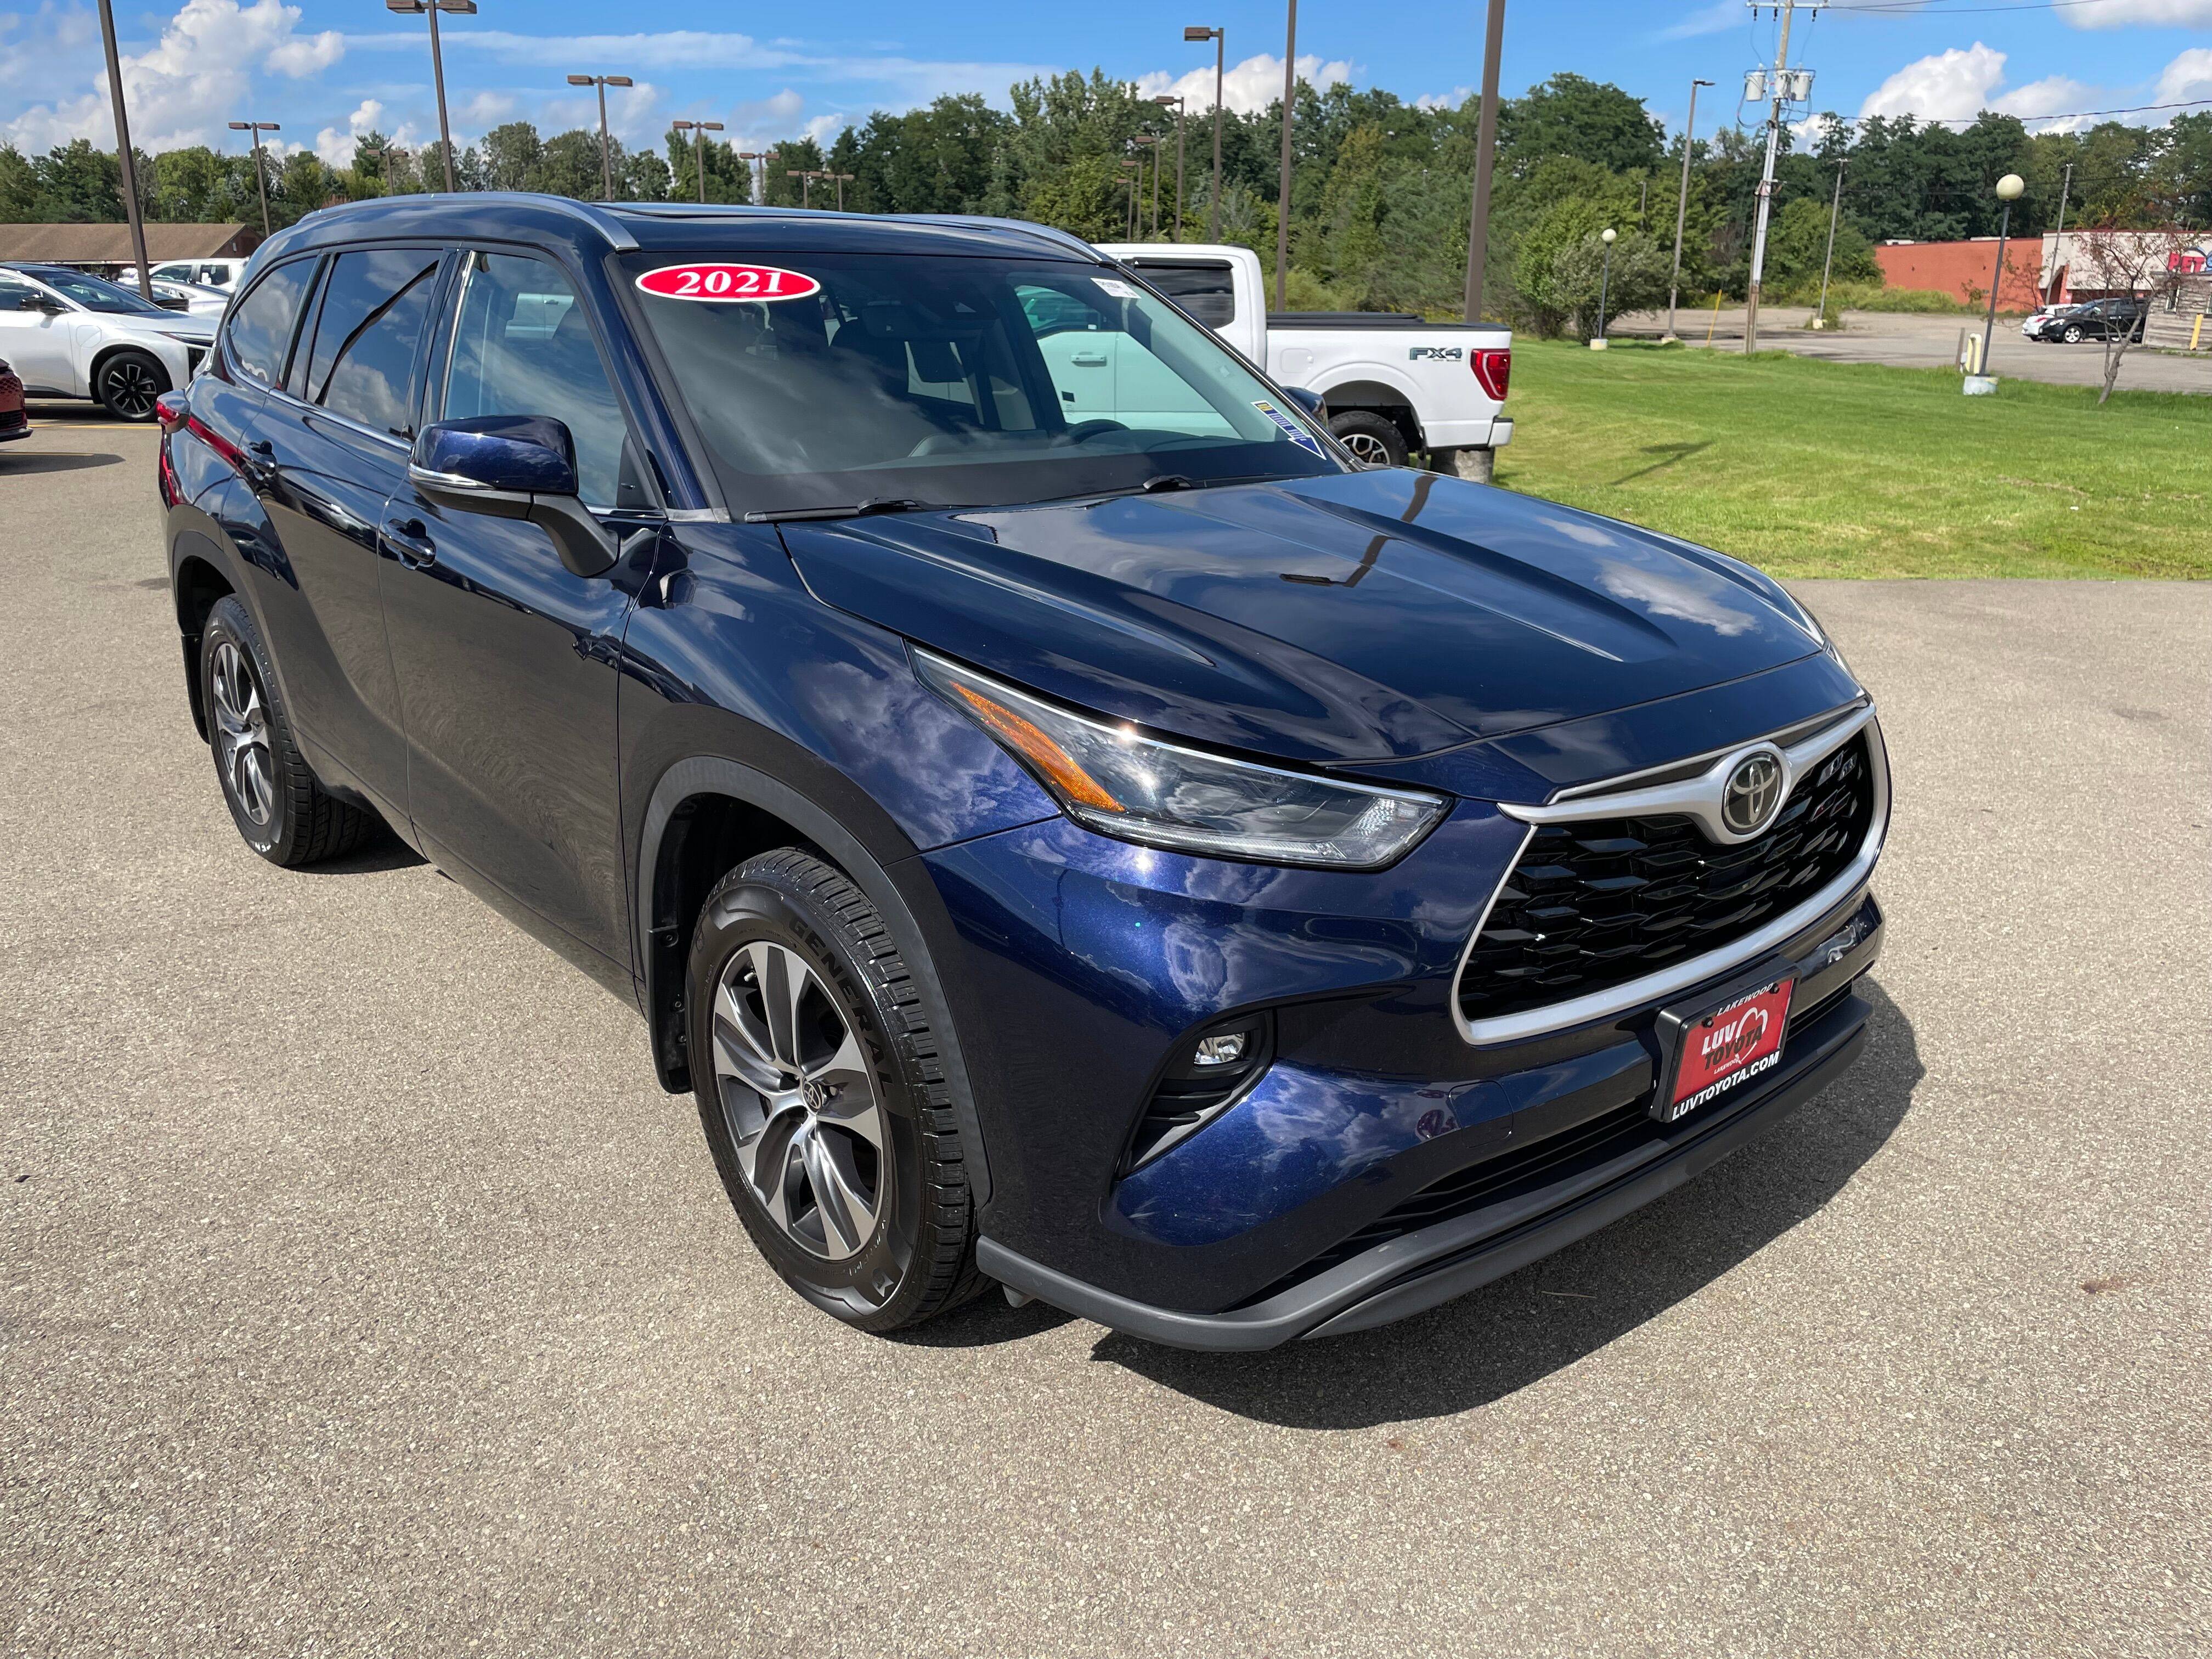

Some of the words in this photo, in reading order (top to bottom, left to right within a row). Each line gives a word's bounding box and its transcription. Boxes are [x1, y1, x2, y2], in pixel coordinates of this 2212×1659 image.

[675, 271, 783, 294] 2021
[1409, 347, 1462, 360] FX4
[789, 918, 894, 1098] GENERAL
[1717, 983, 1773, 1017] LAKEWOOD
[1701, 1020, 1737, 1056] LUV
[1705, 1024, 1763, 1070] TOYOTA
[1672, 1051, 1780, 1120] LUVTOYOTA.COM
